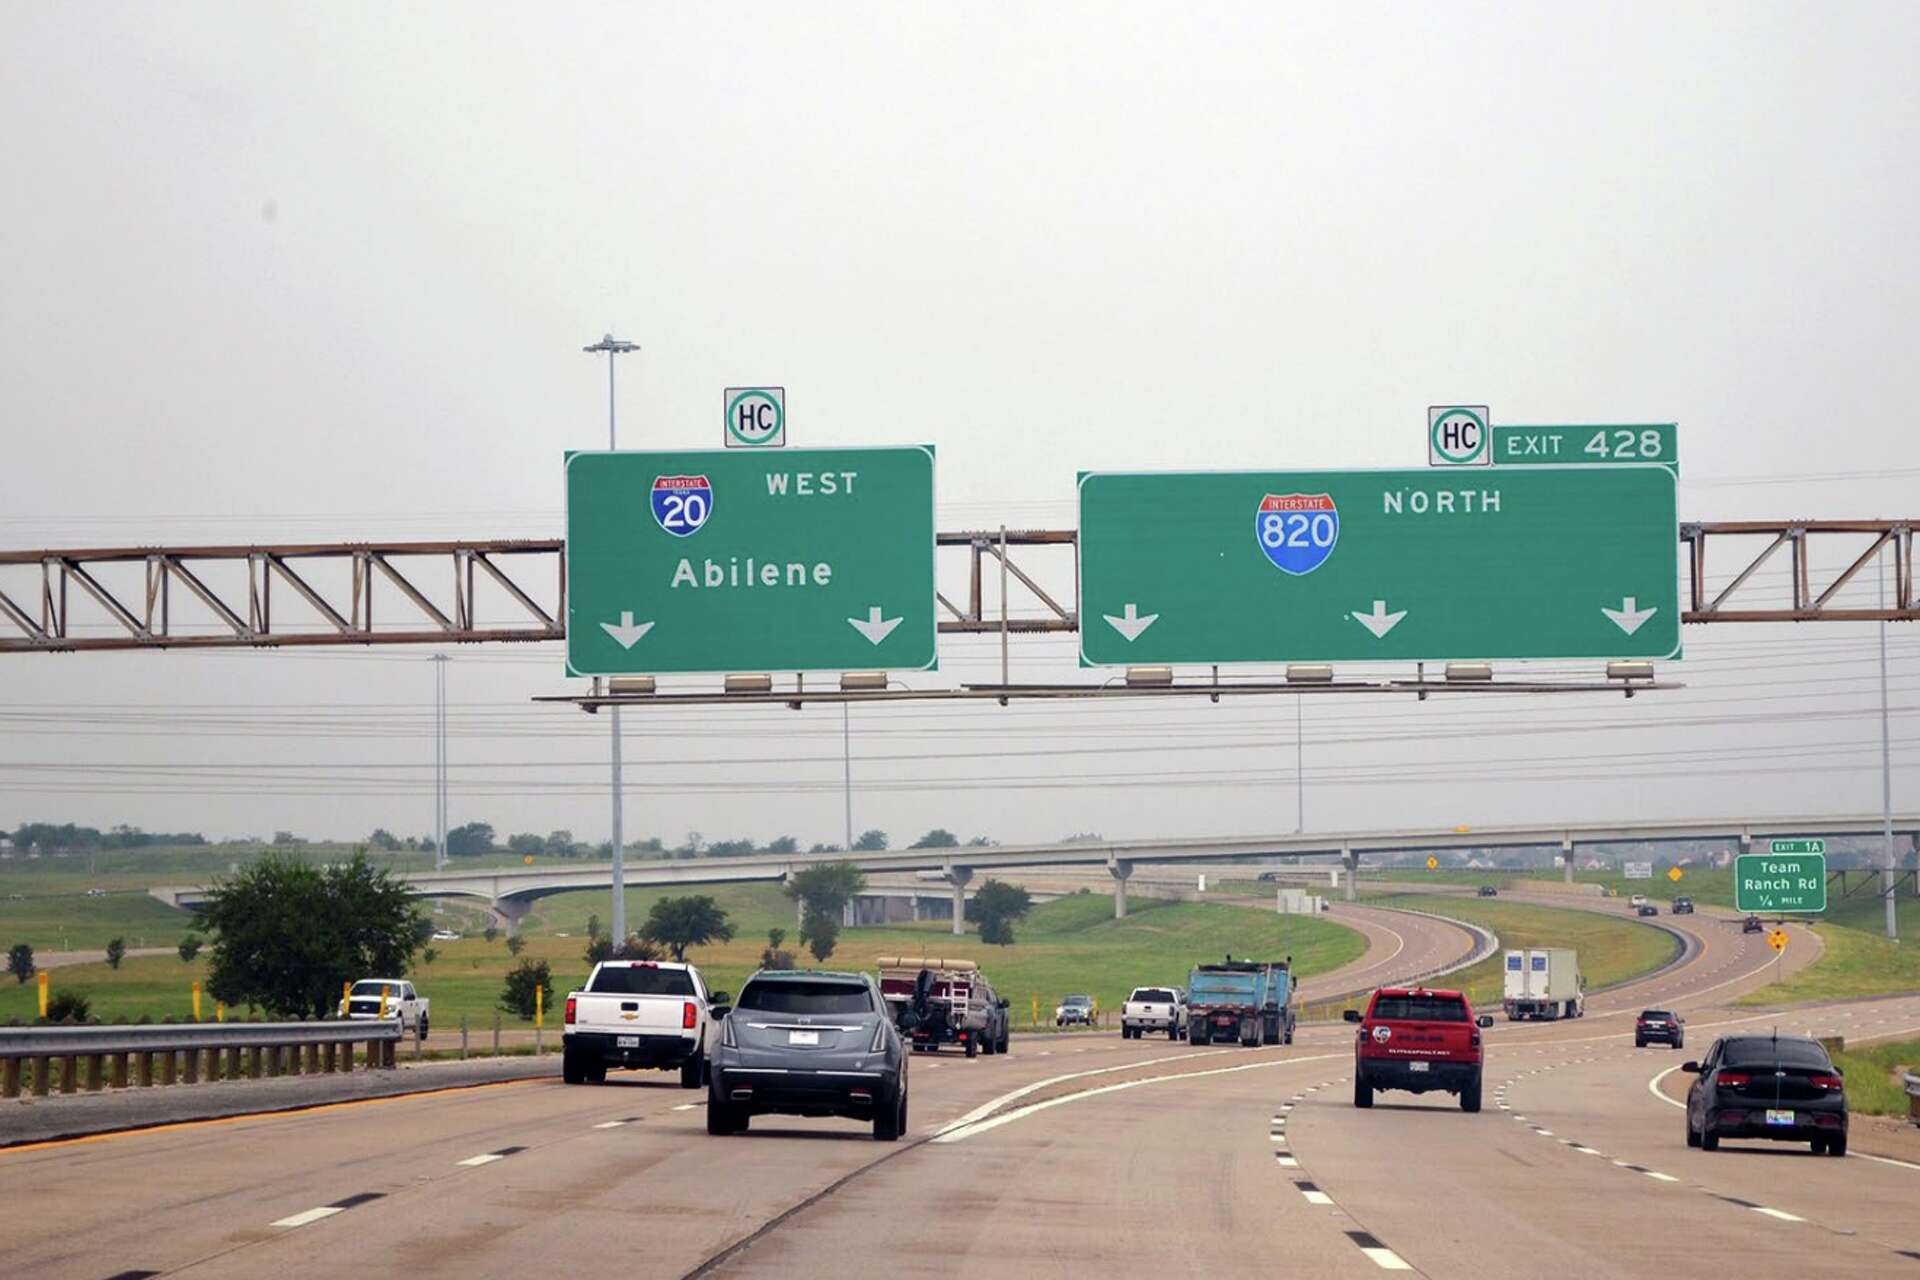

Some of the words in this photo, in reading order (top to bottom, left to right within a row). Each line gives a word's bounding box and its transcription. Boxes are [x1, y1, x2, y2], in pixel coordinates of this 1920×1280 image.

[739, 404, 773, 431] HC
[1443, 421, 1478, 450] HC
[1507, 435, 1564, 456] EXIT
[1584, 430, 1663, 459] 428
[659, 479, 702, 489] INTERSTATE
[766, 471, 858, 496] WEST
[663, 494, 706, 527] 20
[1268, 498, 1326, 510] INTERSTATE
[1383, 490, 1502, 514] NORTH
[1262, 513, 1335, 548] 820
[671, 557, 832, 588] Abilene
[1774, 843, 1794, 851] EXIT
[1805, 842, 1820, 852] 1A
[1760, 862, 1801, 873] Team
[1744, 878, 1790, 890] Ranch
[1798, 878, 1817, 890] Rd
[1781, 896, 1803, 905] MILE
